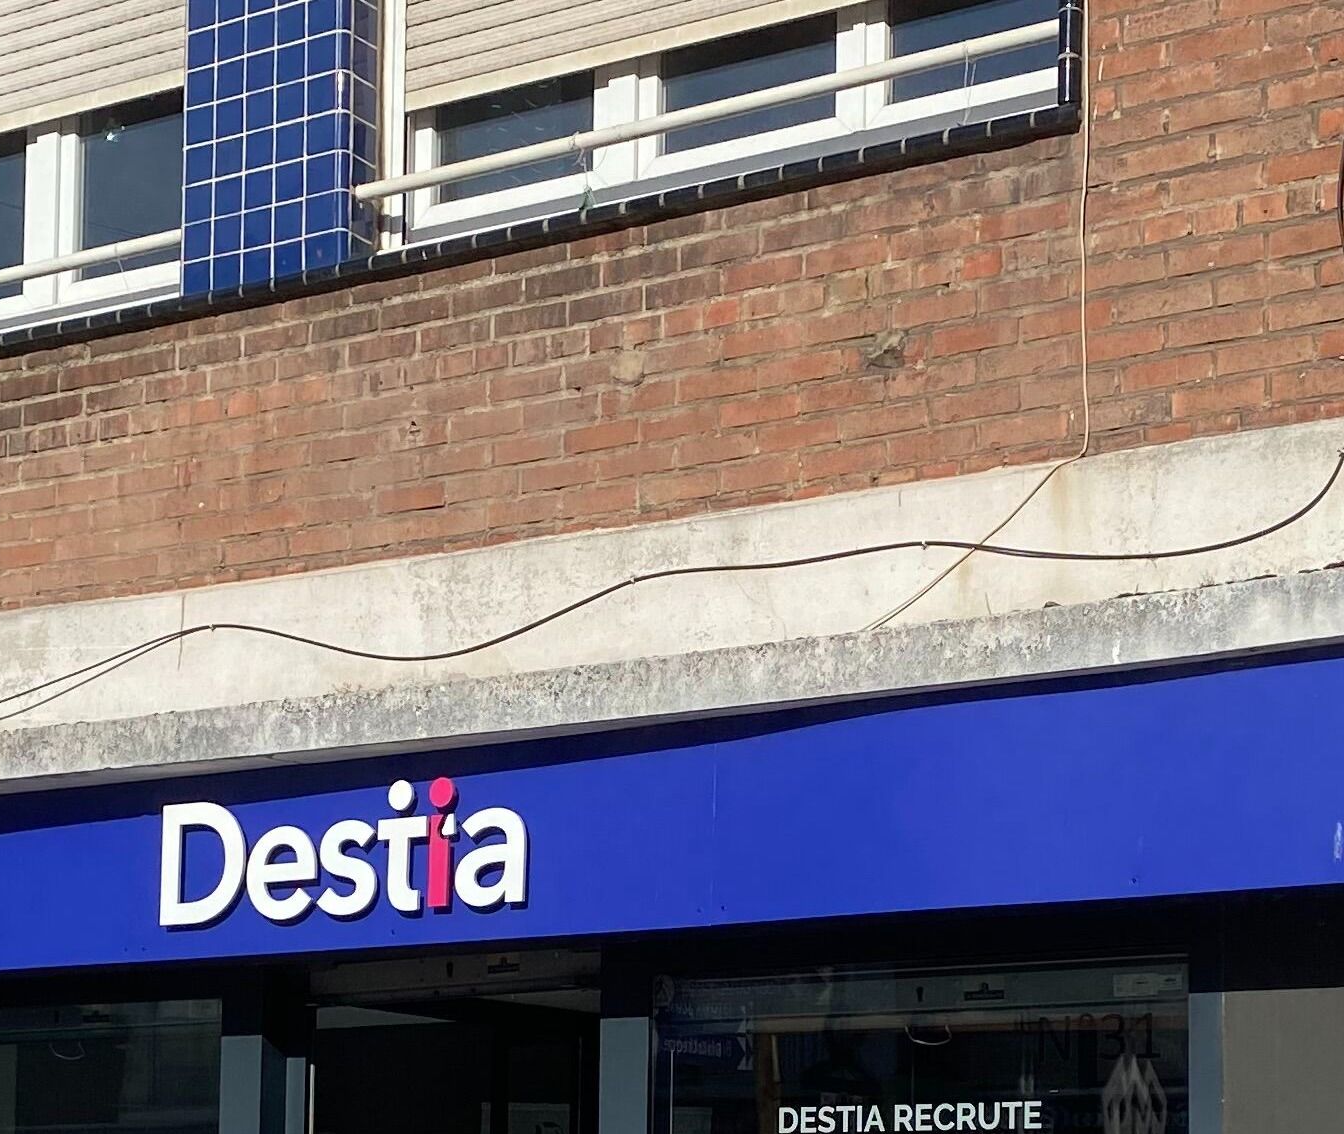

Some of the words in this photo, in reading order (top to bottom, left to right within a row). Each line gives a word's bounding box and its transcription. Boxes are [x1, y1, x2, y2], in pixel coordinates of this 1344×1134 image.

[159, 777, 528, 927] Destia
[778, 1104, 886, 1134] DESTIA
[893, 1100, 1043, 1133] RECRUTE
